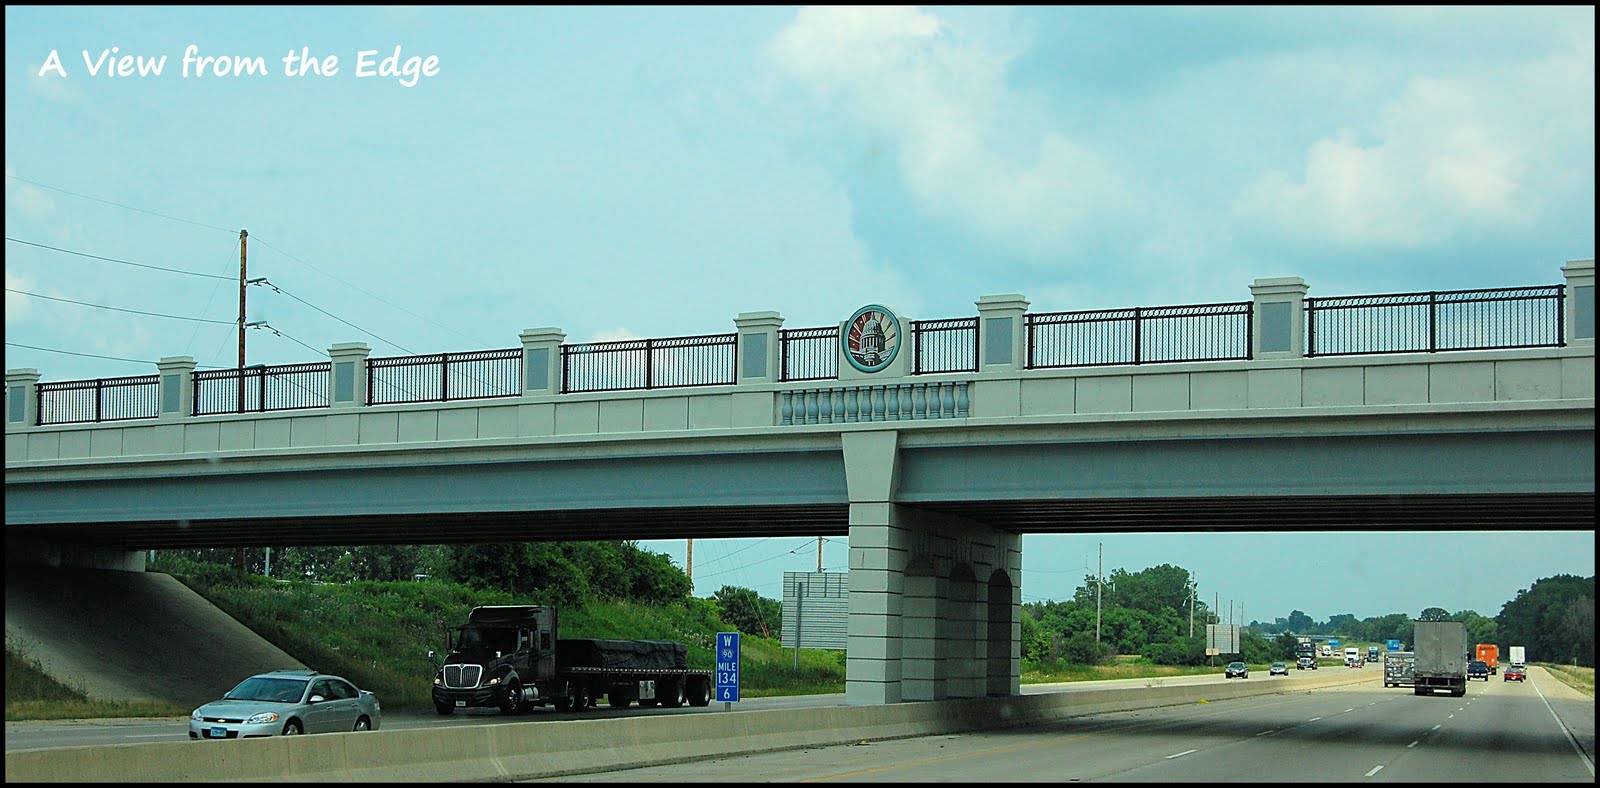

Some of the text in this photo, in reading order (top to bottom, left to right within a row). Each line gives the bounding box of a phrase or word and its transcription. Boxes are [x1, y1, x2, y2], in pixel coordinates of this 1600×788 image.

[723, 635, 732, 647] W
[718, 662, 736, 671] MILE
[718, 672, 736, 684] 134
[723, 688, 731, 699] 6
